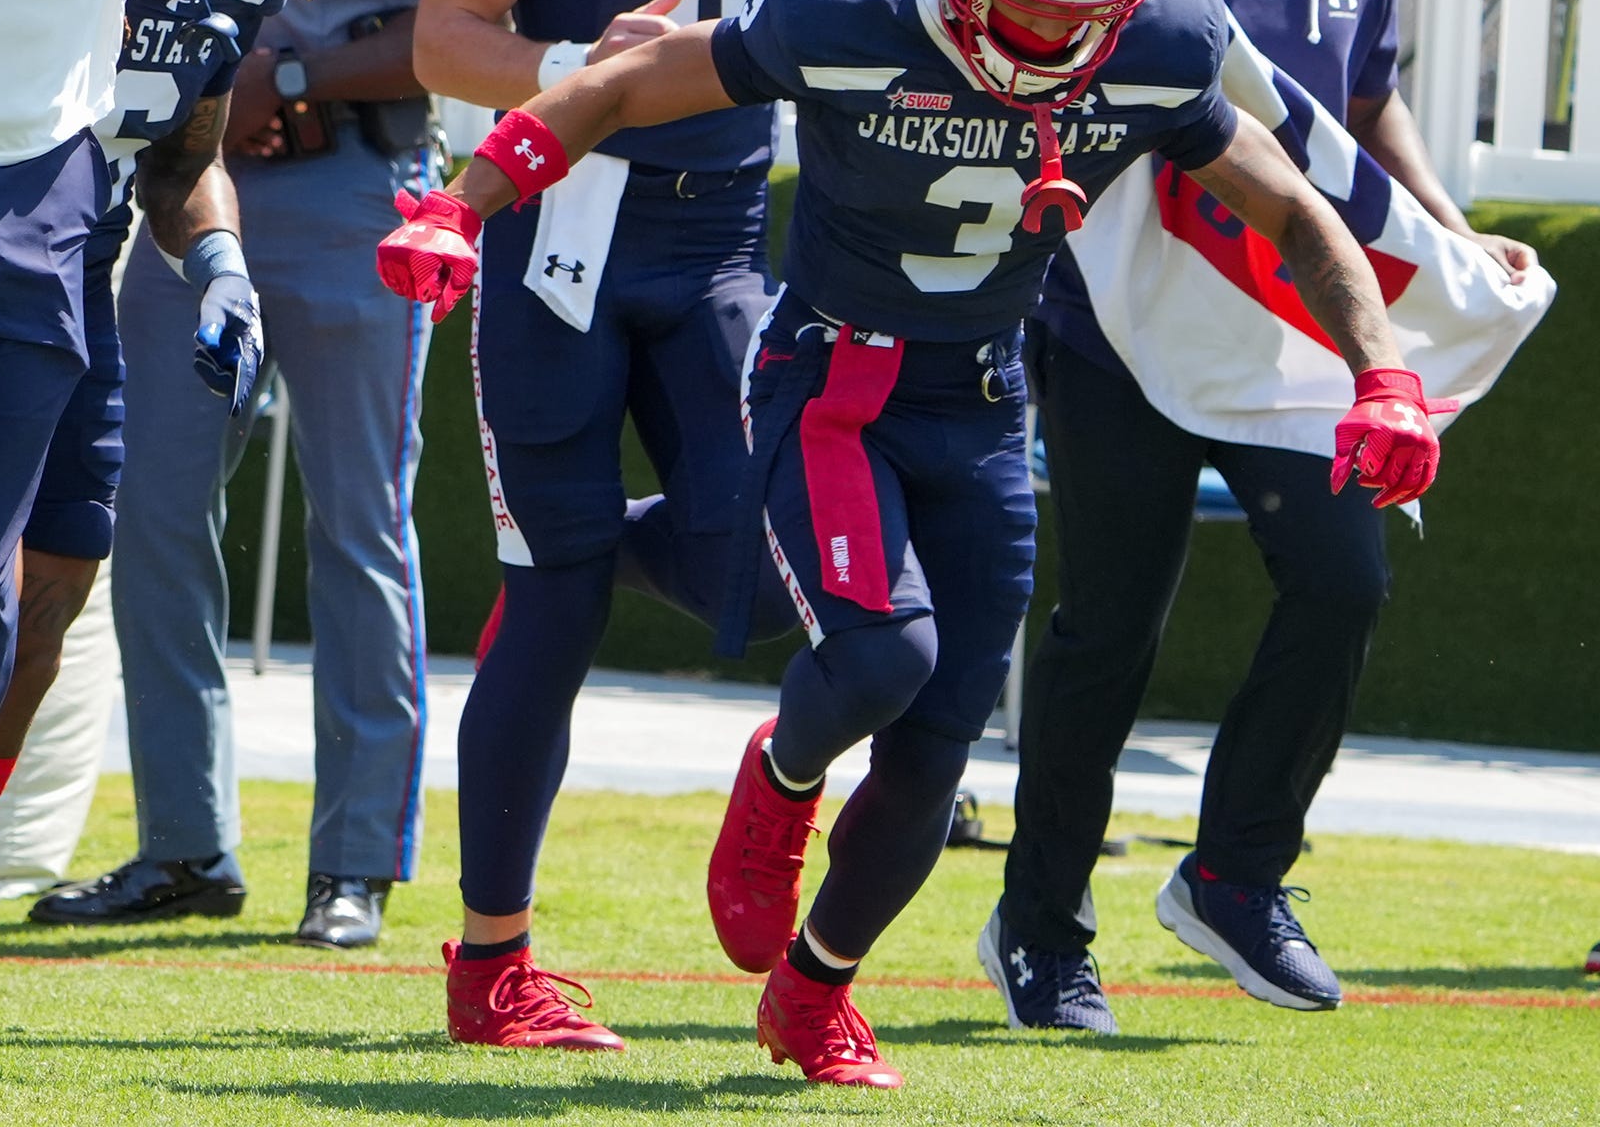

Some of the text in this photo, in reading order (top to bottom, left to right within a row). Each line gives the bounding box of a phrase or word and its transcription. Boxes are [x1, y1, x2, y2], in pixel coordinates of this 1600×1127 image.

[905, 91, 953, 111] SWAC
[858, 113, 1007, 160] JACKSON
[900, 165, 1030, 293] 3
